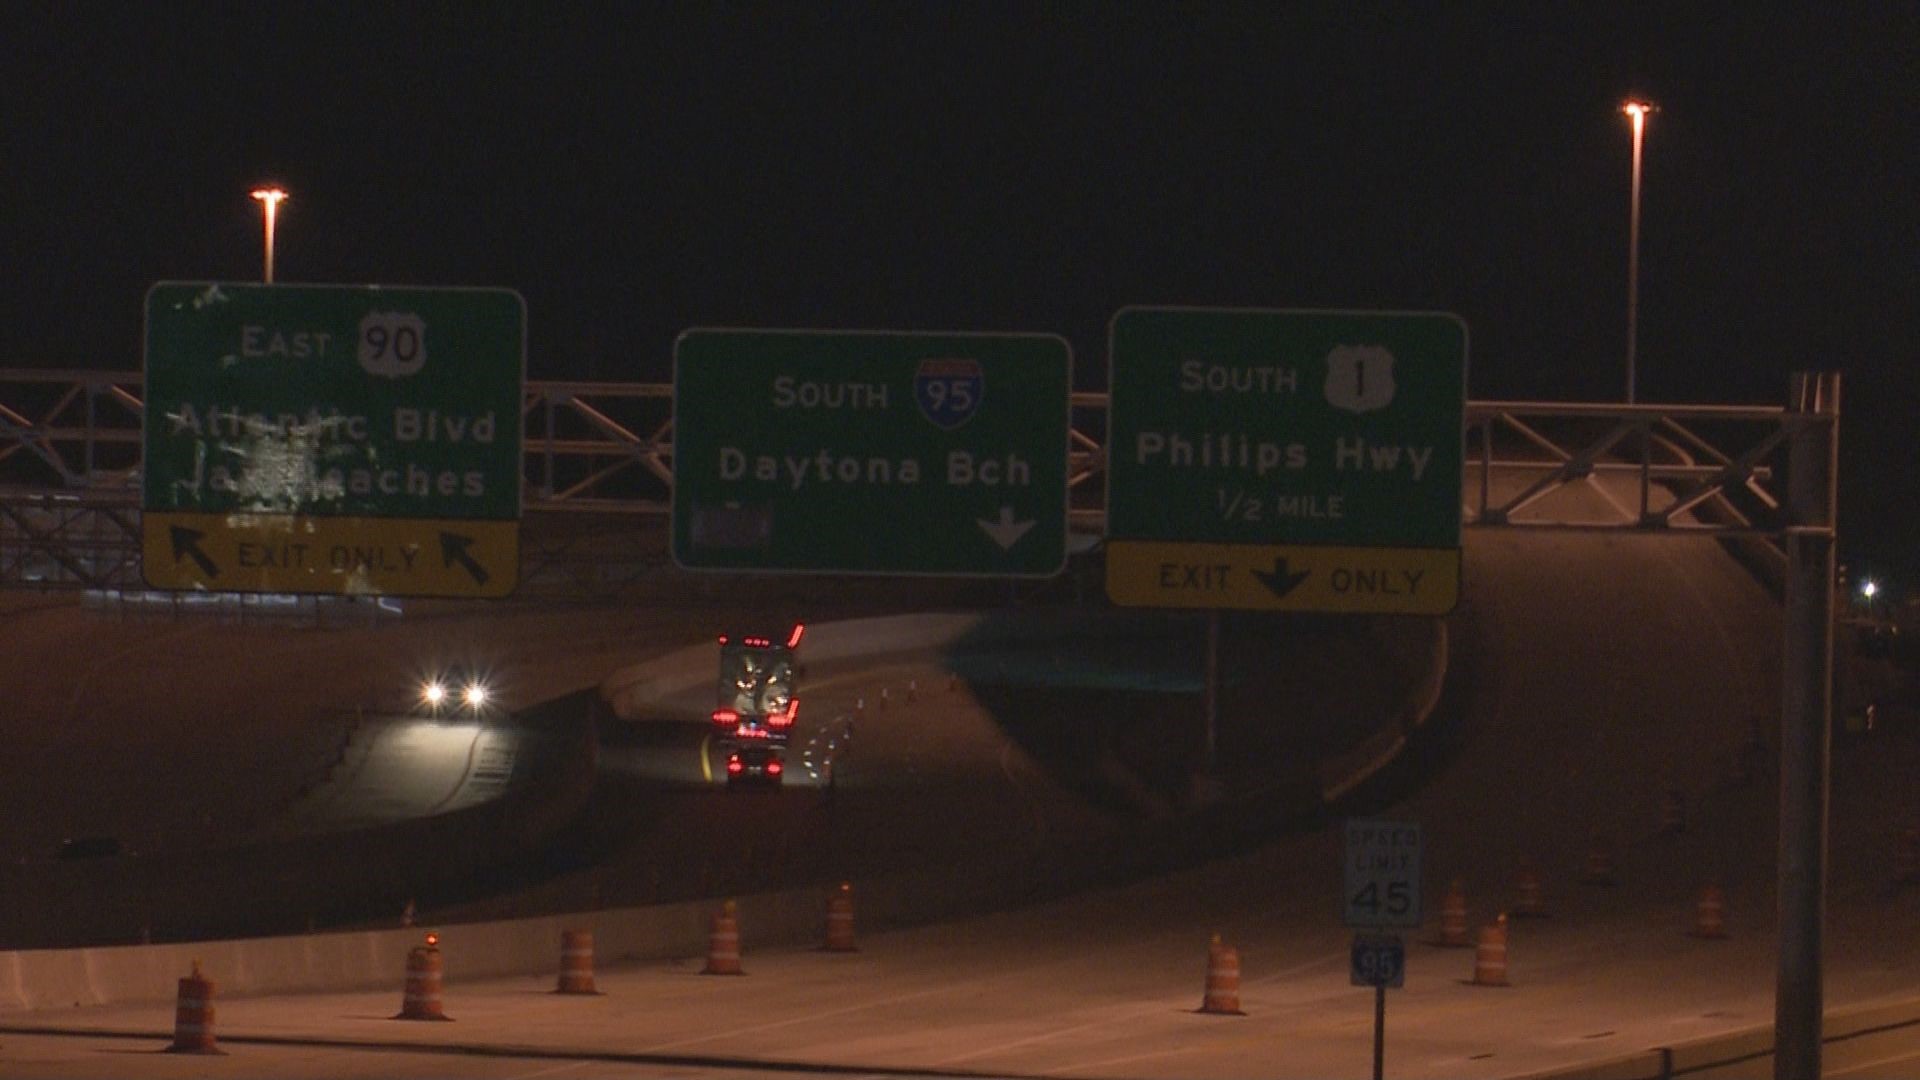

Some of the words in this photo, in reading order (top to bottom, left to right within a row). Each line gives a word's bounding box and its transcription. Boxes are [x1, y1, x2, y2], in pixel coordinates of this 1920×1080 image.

[241, 324, 330, 357] EAST
[366, 325, 418, 363] 90
[773, 375, 888, 410] SOUTH
[926, 379, 971, 412] 95
[1180, 358, 1297, 394] SOUTH
[1354, 358, 1365, 398] 1
[392, 407, 496, 442] Blvd
[718, 446, 922, 489] Daytona
[946, 449, 1031, 486] Bch
[1136, 431, 1308, 475] Philips
[1335, 437, 1433, 482] Hwy
[173, 458, 255, 496] Ja
[293, 461, 485, 498] eaches
[1278, 496, 1344, 519] MILE
[238, 543, 308, 568] EXIT
[330, 545, 419, 571] ONLY
[1159, 564, 1231, 591] EXIT
[1331, 568, 1425, 596] ONLY
[1352, 880, 1410, 915] 45
[1361, 949, 1394, 981] 95
